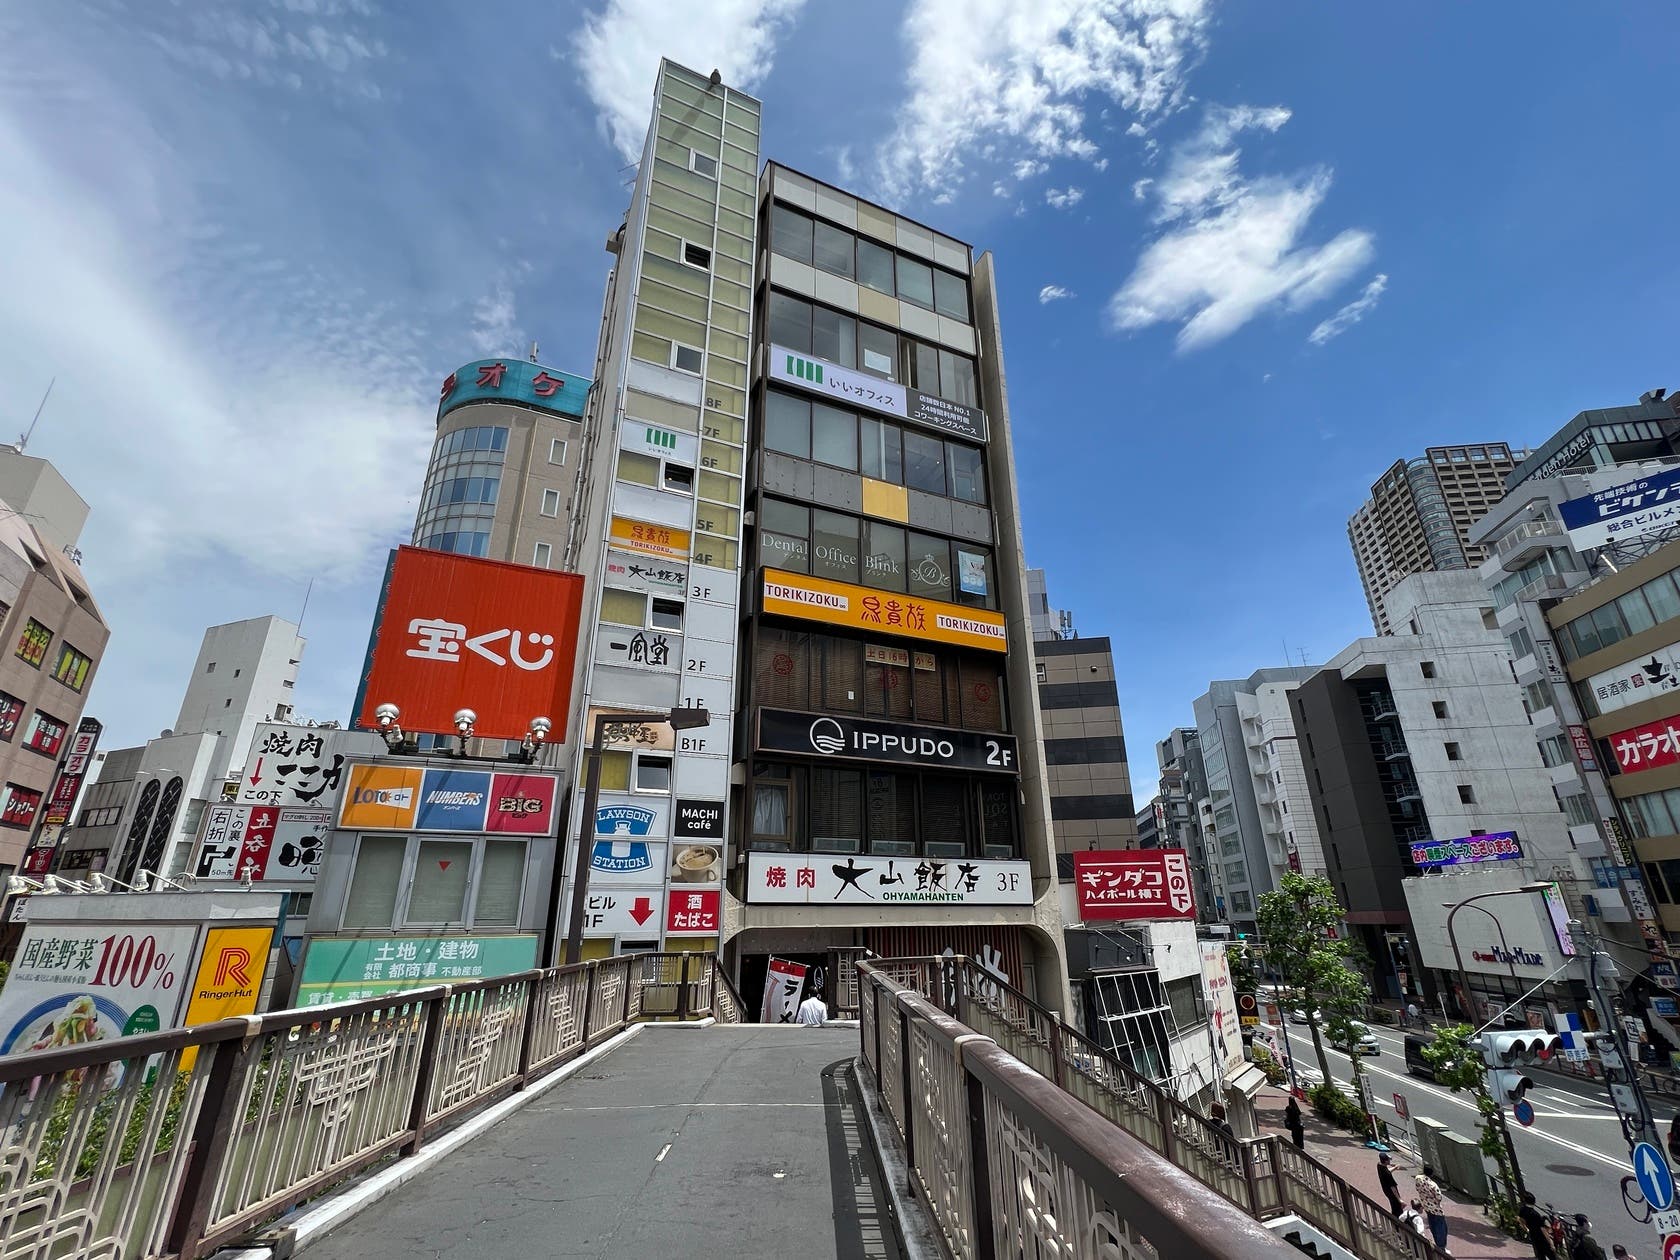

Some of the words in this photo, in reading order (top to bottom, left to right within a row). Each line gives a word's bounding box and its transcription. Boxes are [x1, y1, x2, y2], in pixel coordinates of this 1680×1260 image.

[829, 377, 895, 407] いいオフィス
[706, 397, 722, 410] 8F
[914, 410, 977, 435] コワーキングスペース
[704, 426, 720, 439] 7F
[701, 456, 718, 469] 6F
[697, 519, 714, 532] 5F
[630, 540, 670, 553] TORIKIZOKU
[762, 533, 809, 555] Dental
[815, 545, 857, 565] Office
[865, 555, 899, 574] Blink
[695, 552, 712, 565] 4F
[628, 564, 685, 584] 大山飯店
[692, 586, 711, 599] 3F
[765, 584, 839, 608] TORIKIZOKU
[939, 616, 999, 636] TORIKIZOKU
[406, 618, 554, 671] 宝くじ
[610, 632, 670, 665] 一風堂
[687, 660, 706, 672] 2F
[914, 656, 934, 667] から
[259, 730, 325, 759] 焼肉
[681, 737, 706, 751] B1F
[853, 730, 954, 758] IPPUDO
[986, 740, 1012, 767] 2F
[244, 789, 283, 801] この下
[352, 786, 389, 805] LOTO
[426, 790, 483, 806] NUMBERS
[498, 797, 542, 813] BIG
[597, 808, 651, 823] LAWSON
[681, 808, 718, 820] MACHI
[208, 811, 229, 841] 右折
[228, 809, 245, 842] この裏
[687, 820, 711, 831] café
[593, 856, 647, 869] STATION
[766, 866, 815, 889] 焼肉
[831, 858, 980, 900] 大山飯店
[997, 872, 1019, 892] 3F
[1082, 868, 1163, 888] ギンダコ
[1166, 857, 1191, 908] この下
[687, 894, 702, 909] 酒
[882, 892, 964, 902] OHYAMAHANTEN
[674, 911, 713, 928] たばこ
[374, 941, 480, 961] 土地・建物
[19, 937, 99, 971] 国産野菜
[88, 934, 175, 990] 100%
[213, 947, 251, 988] R
[363, 971, 381, 980] 会社
[388, 962, 437, 979] 都商事
[441, 966, 482, 976] 不動産部
[199, 990, 234, 1000] Ringer
[234, 988, 253, 999] Hut
